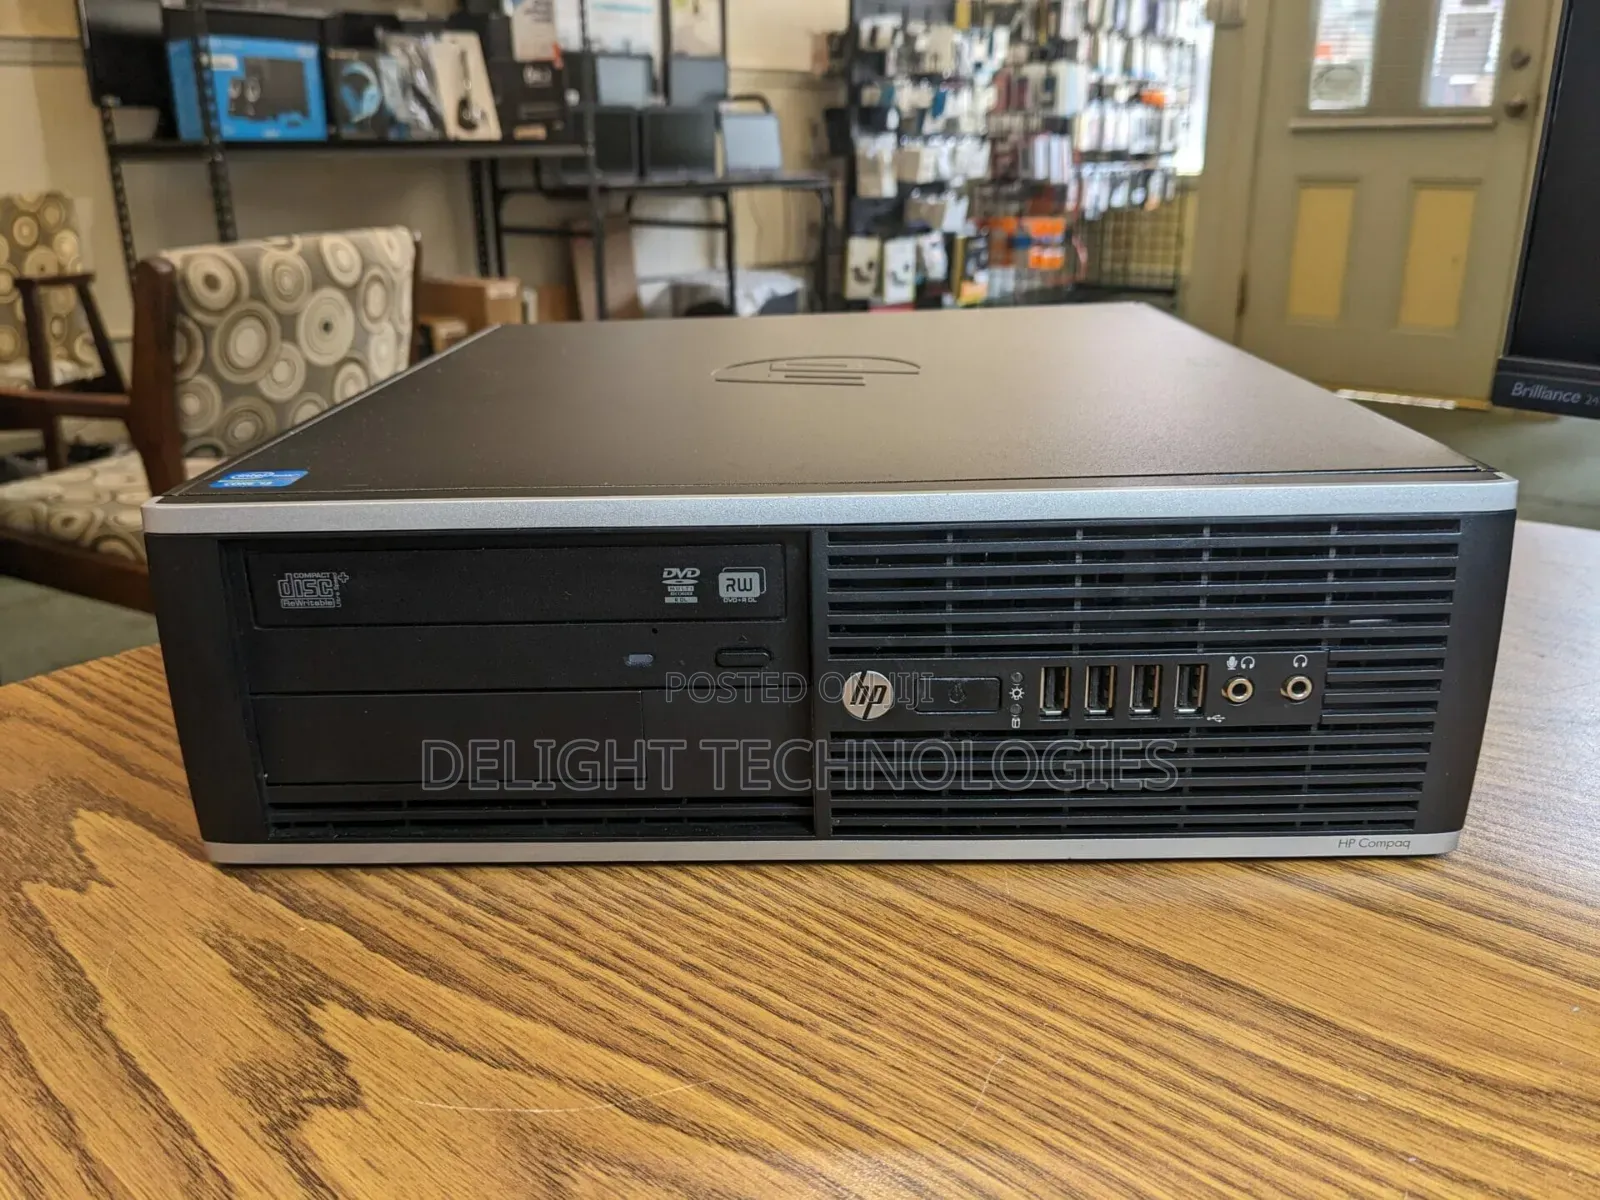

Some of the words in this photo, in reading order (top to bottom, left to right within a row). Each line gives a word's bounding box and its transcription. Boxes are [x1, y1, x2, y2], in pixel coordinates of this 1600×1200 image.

[1510, 382, 1581, 404] Brilliance
[662, 567, 701, 579] DVD
[725, 577, 754, 593] RW
[283, 599, 333, 607] ReWritable
[847, 671, 889, 719] hp
[1337, 838, 1356, 849] HP
[1358, 837, 1411, 851] Compaq
